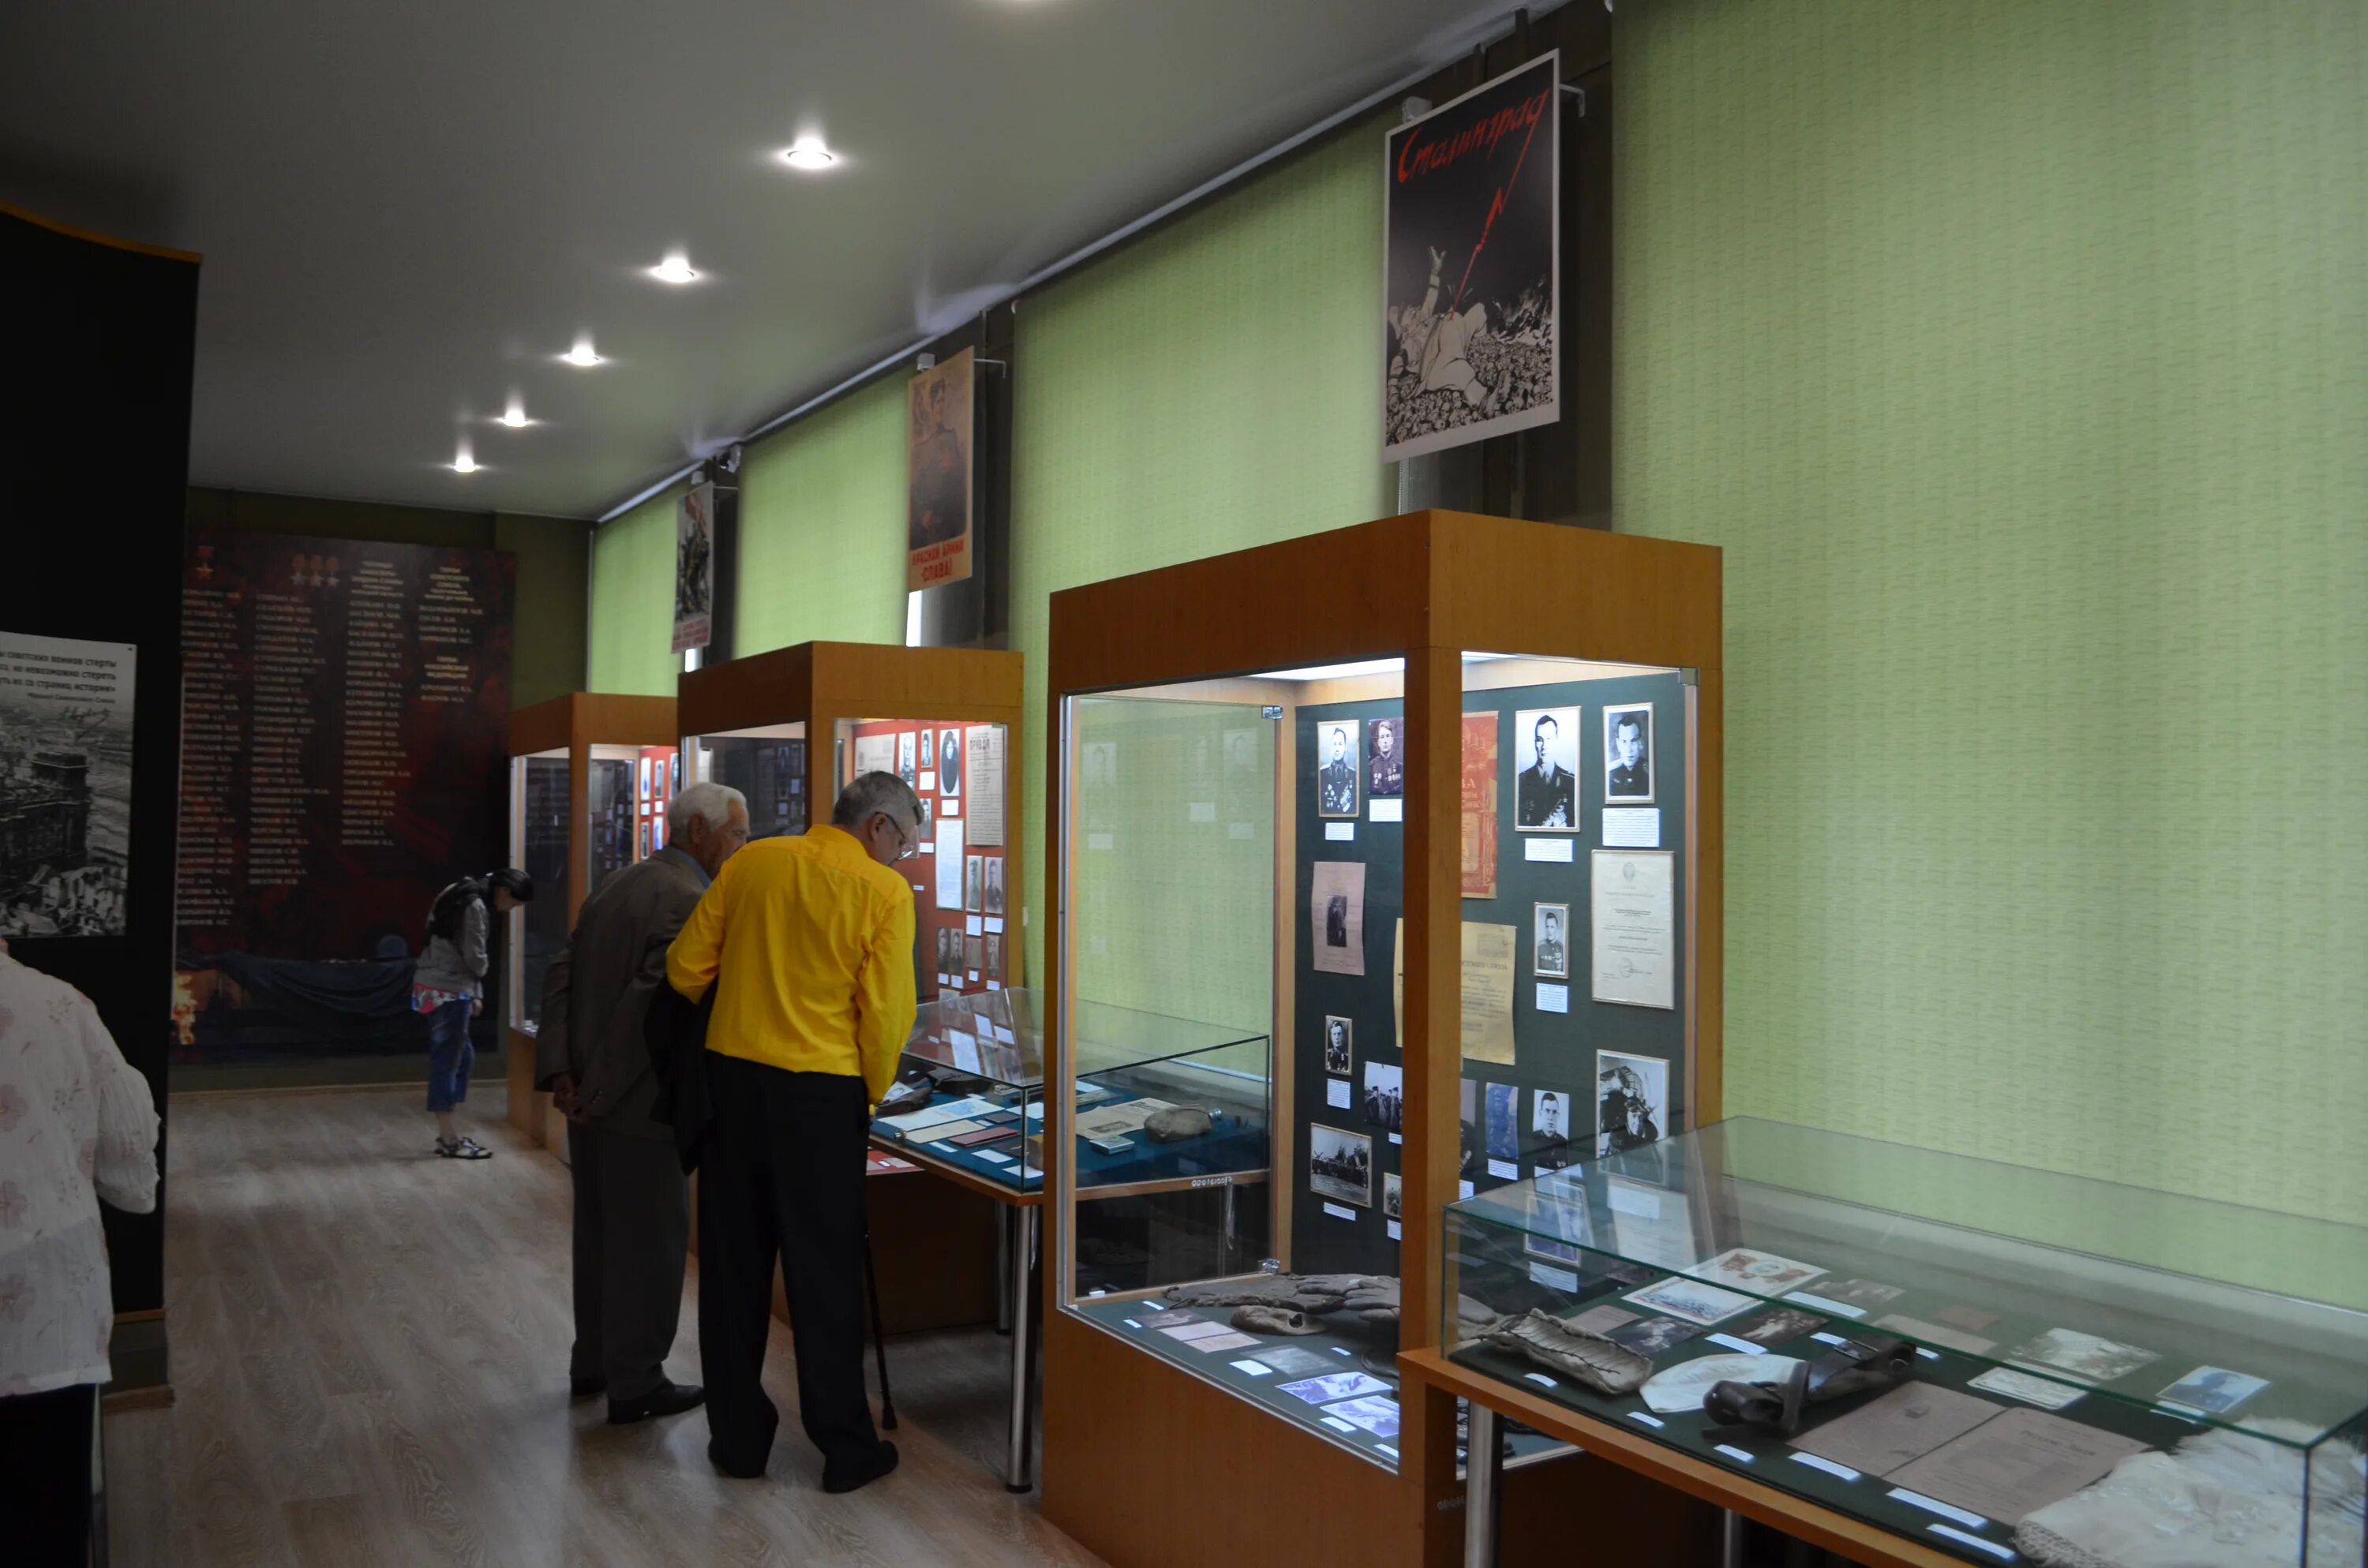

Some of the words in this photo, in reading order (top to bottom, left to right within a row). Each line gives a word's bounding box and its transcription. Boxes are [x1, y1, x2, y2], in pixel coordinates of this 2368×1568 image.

[1397, 88, 1550, 183] Сталинград
[51, 655, 83, 665] воинов
[25, 666, 80, 677] невозможно
